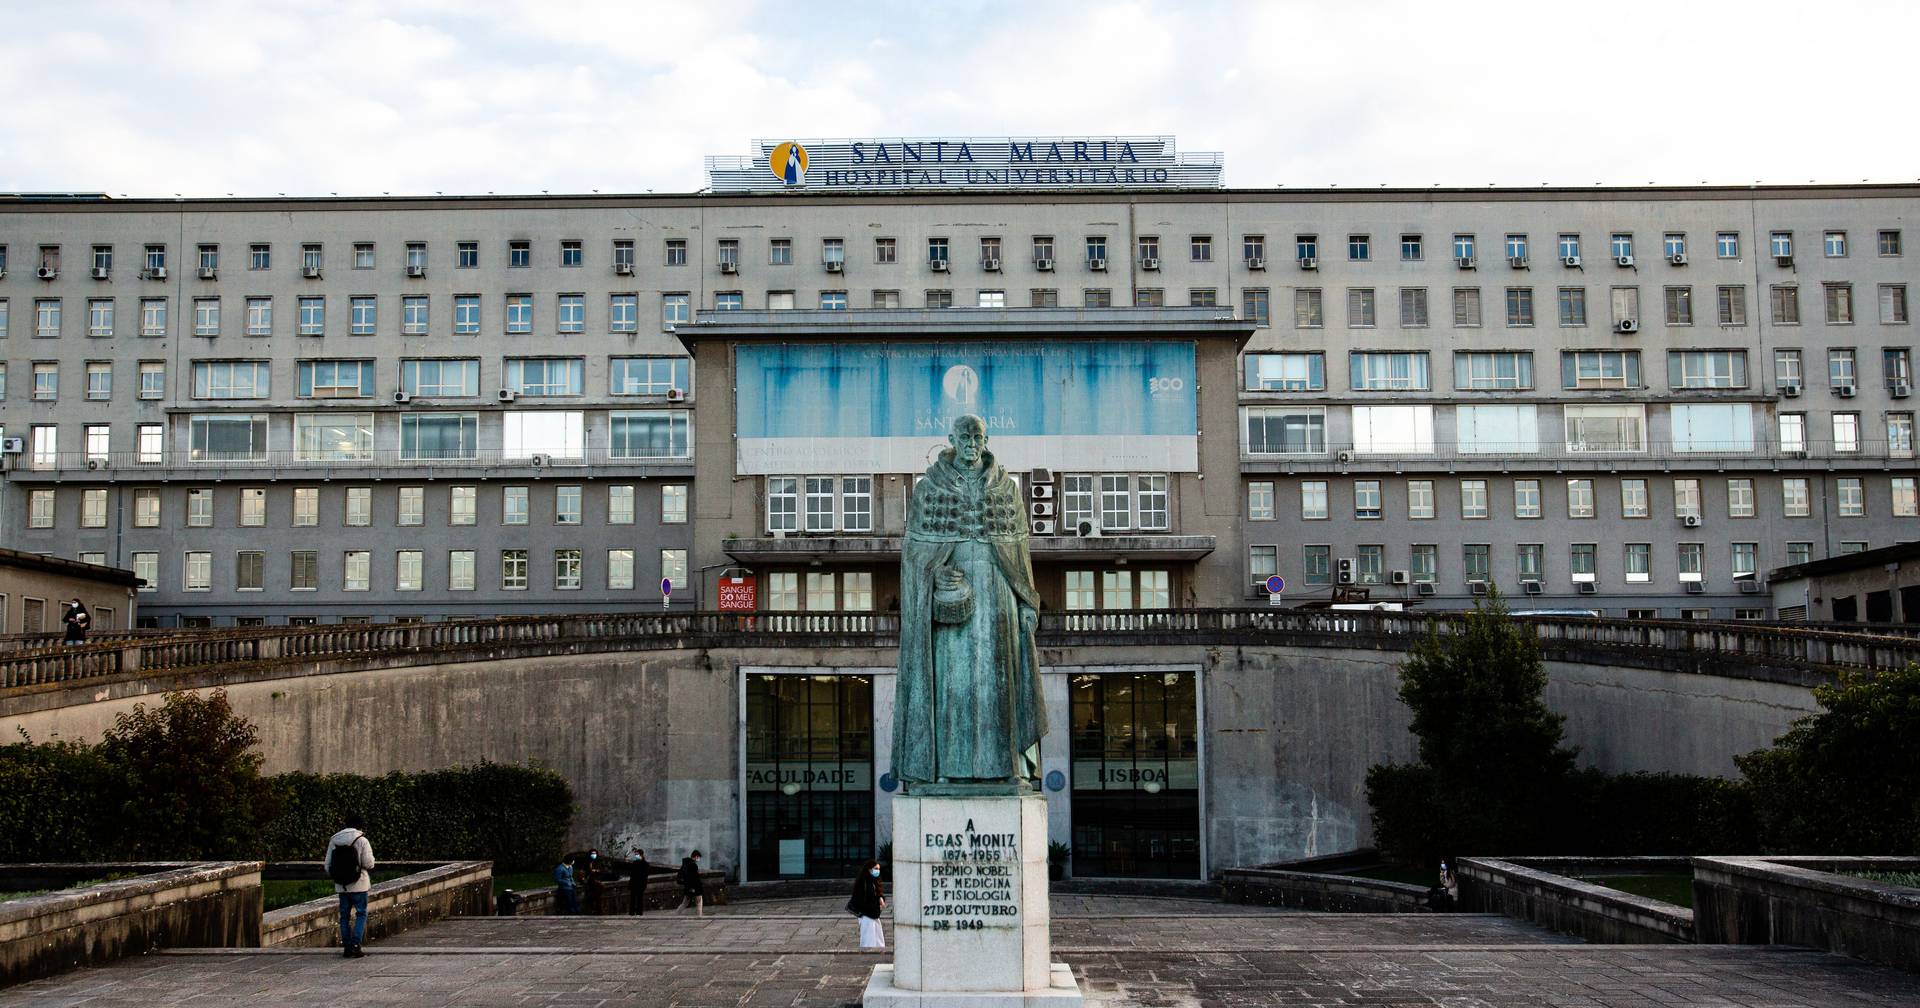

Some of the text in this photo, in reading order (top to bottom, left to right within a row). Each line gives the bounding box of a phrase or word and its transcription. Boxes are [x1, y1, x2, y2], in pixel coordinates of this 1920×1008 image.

[852, 141, 1138, 163] SANTA MARIA
[825, 165, 1168, 185] HOSPITAL UNIVERSITÁRIO
[916, 416, 1016, 429] SANT ARIA
[1097, 769, 1166, 783] LISBOA
[965, 818, 975, 832] A
[925, 834, 1016, 848] EGAS MONIZ
[977, 865, 1013, 876] NOBEL
[931, 877, 1011, 889] DE MEDICINA
[931, 890, 1012, 901] E FISIOLOGIA
[933, 920, 984, 931] DE 1949
